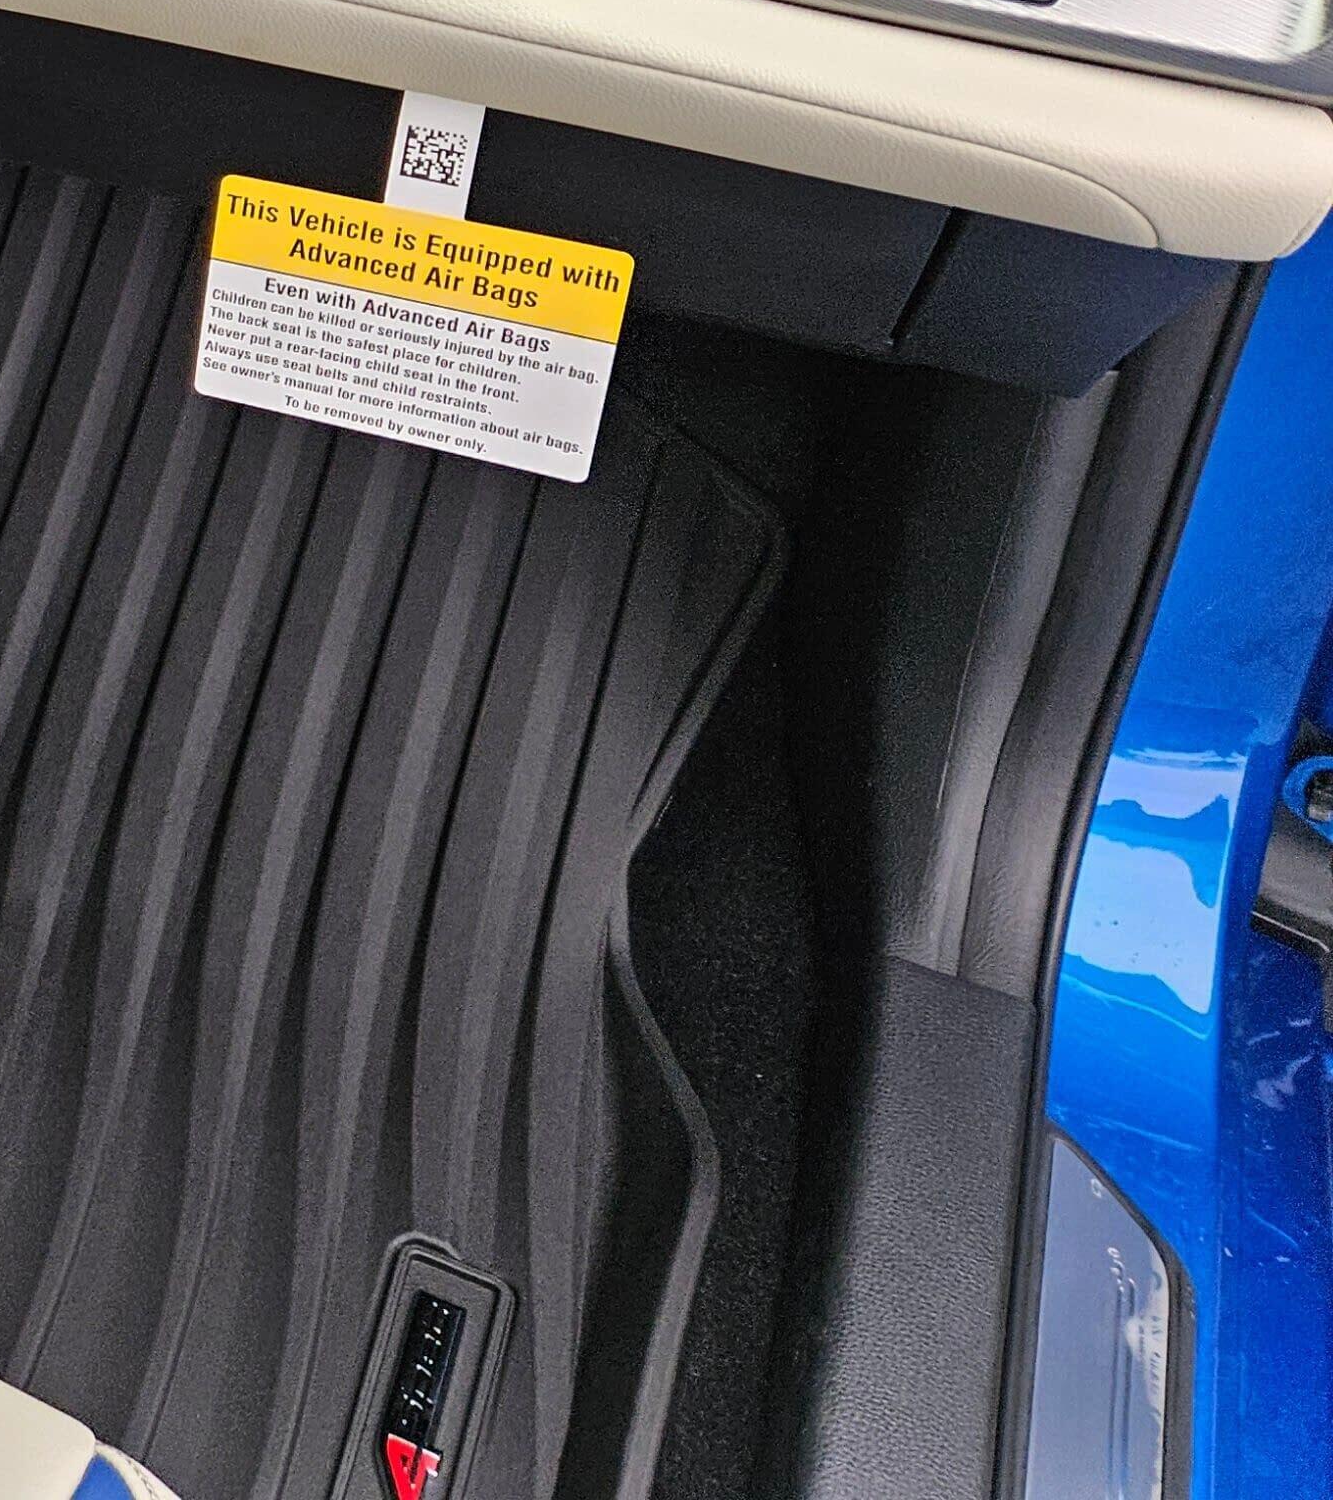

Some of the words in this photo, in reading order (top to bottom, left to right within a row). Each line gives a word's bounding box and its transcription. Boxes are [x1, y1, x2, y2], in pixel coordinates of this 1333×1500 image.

[227, 193, 279, 223] This
[289, 206, 384, 244] Vehicle
[394, 227, 417, 251] is
[426, 233, 553, 278] Equipped
[562, 265, 620, 293] with
[289, 238, 416, 282] Advanced
[424, 267, 464, 292] Air
[472, 275, 539, 308] Bags
[210, 305, 233, 320] The
[238, 312, 268, 328] back
[273, 321, 301, 336] seat
[305, 326, 317, 339] is
[322, 330, 342, 345] the
[347, 337, 389, 355] safest
[393, 348, 431, 364] place
[435, 355, 455, 369] for
[459, 361, 521, 385] children.
[212, 288, 267, 310] Children
[271, 303, 294, 316] can
[298, 307, 314, 320] be
[318, 311, 355, 329] killed
[360, 322, 374, 333] or
[377, 326, 440, 350] seriously
[444, 338, 494, 360] injured
[498, 350, 514, 366] by
[519, 355, 540, 370] the
[545, 362, 565, 375] air
[568, 366, 599, 384] bag.
[264, 277, 309, 300] Even
[316, 290, 356, 310] with
[362, 299, 459, 332] Advanced
[465, 320, 495, 340] Air
[501, 328, 551, 352] Bags
[205, 340, 251, 360] Always
[255, 353, 279, 366] use
[283, 358, 311, 374] seat
[315, 364, 348, 382] belts
[353, 374, 378, 388] and
[382, 381, 417, 397] child
[420, 390, 492, 415] restraints.
[207, 323, 246, 340] Never
[250, 333, 271, 347] put
[274, 339, 283, 349] a
[286, 341, 362, 369] rear-facing
[365, 359, 399, 375] child
[403, 368, 433, 384] seat
[438, 373, 450, 387] in
[455, 377, 477, 393] the
[482, 383, 519, 403] front.
[202, 356, 227, 372] See
[230, 364, 280, 384] owner's
[284, 376, 333, 396] manual
[337, 387, 355, 400] for
[359, 394, 393, 410] more
[398, 400, 476, 429] information
[479, 421, 519, 439] about
[523, 431, 543, 444] air
[546, 435, 583, 455] bags.
[284, 394, 299, 408] To
[304, 398, 320, 413] be
[324, 405, 383, 428] removed
[388, 419, 404, 435] by
[408, 427, 451, 444] owner
[455, 434, 487, 453] only.
